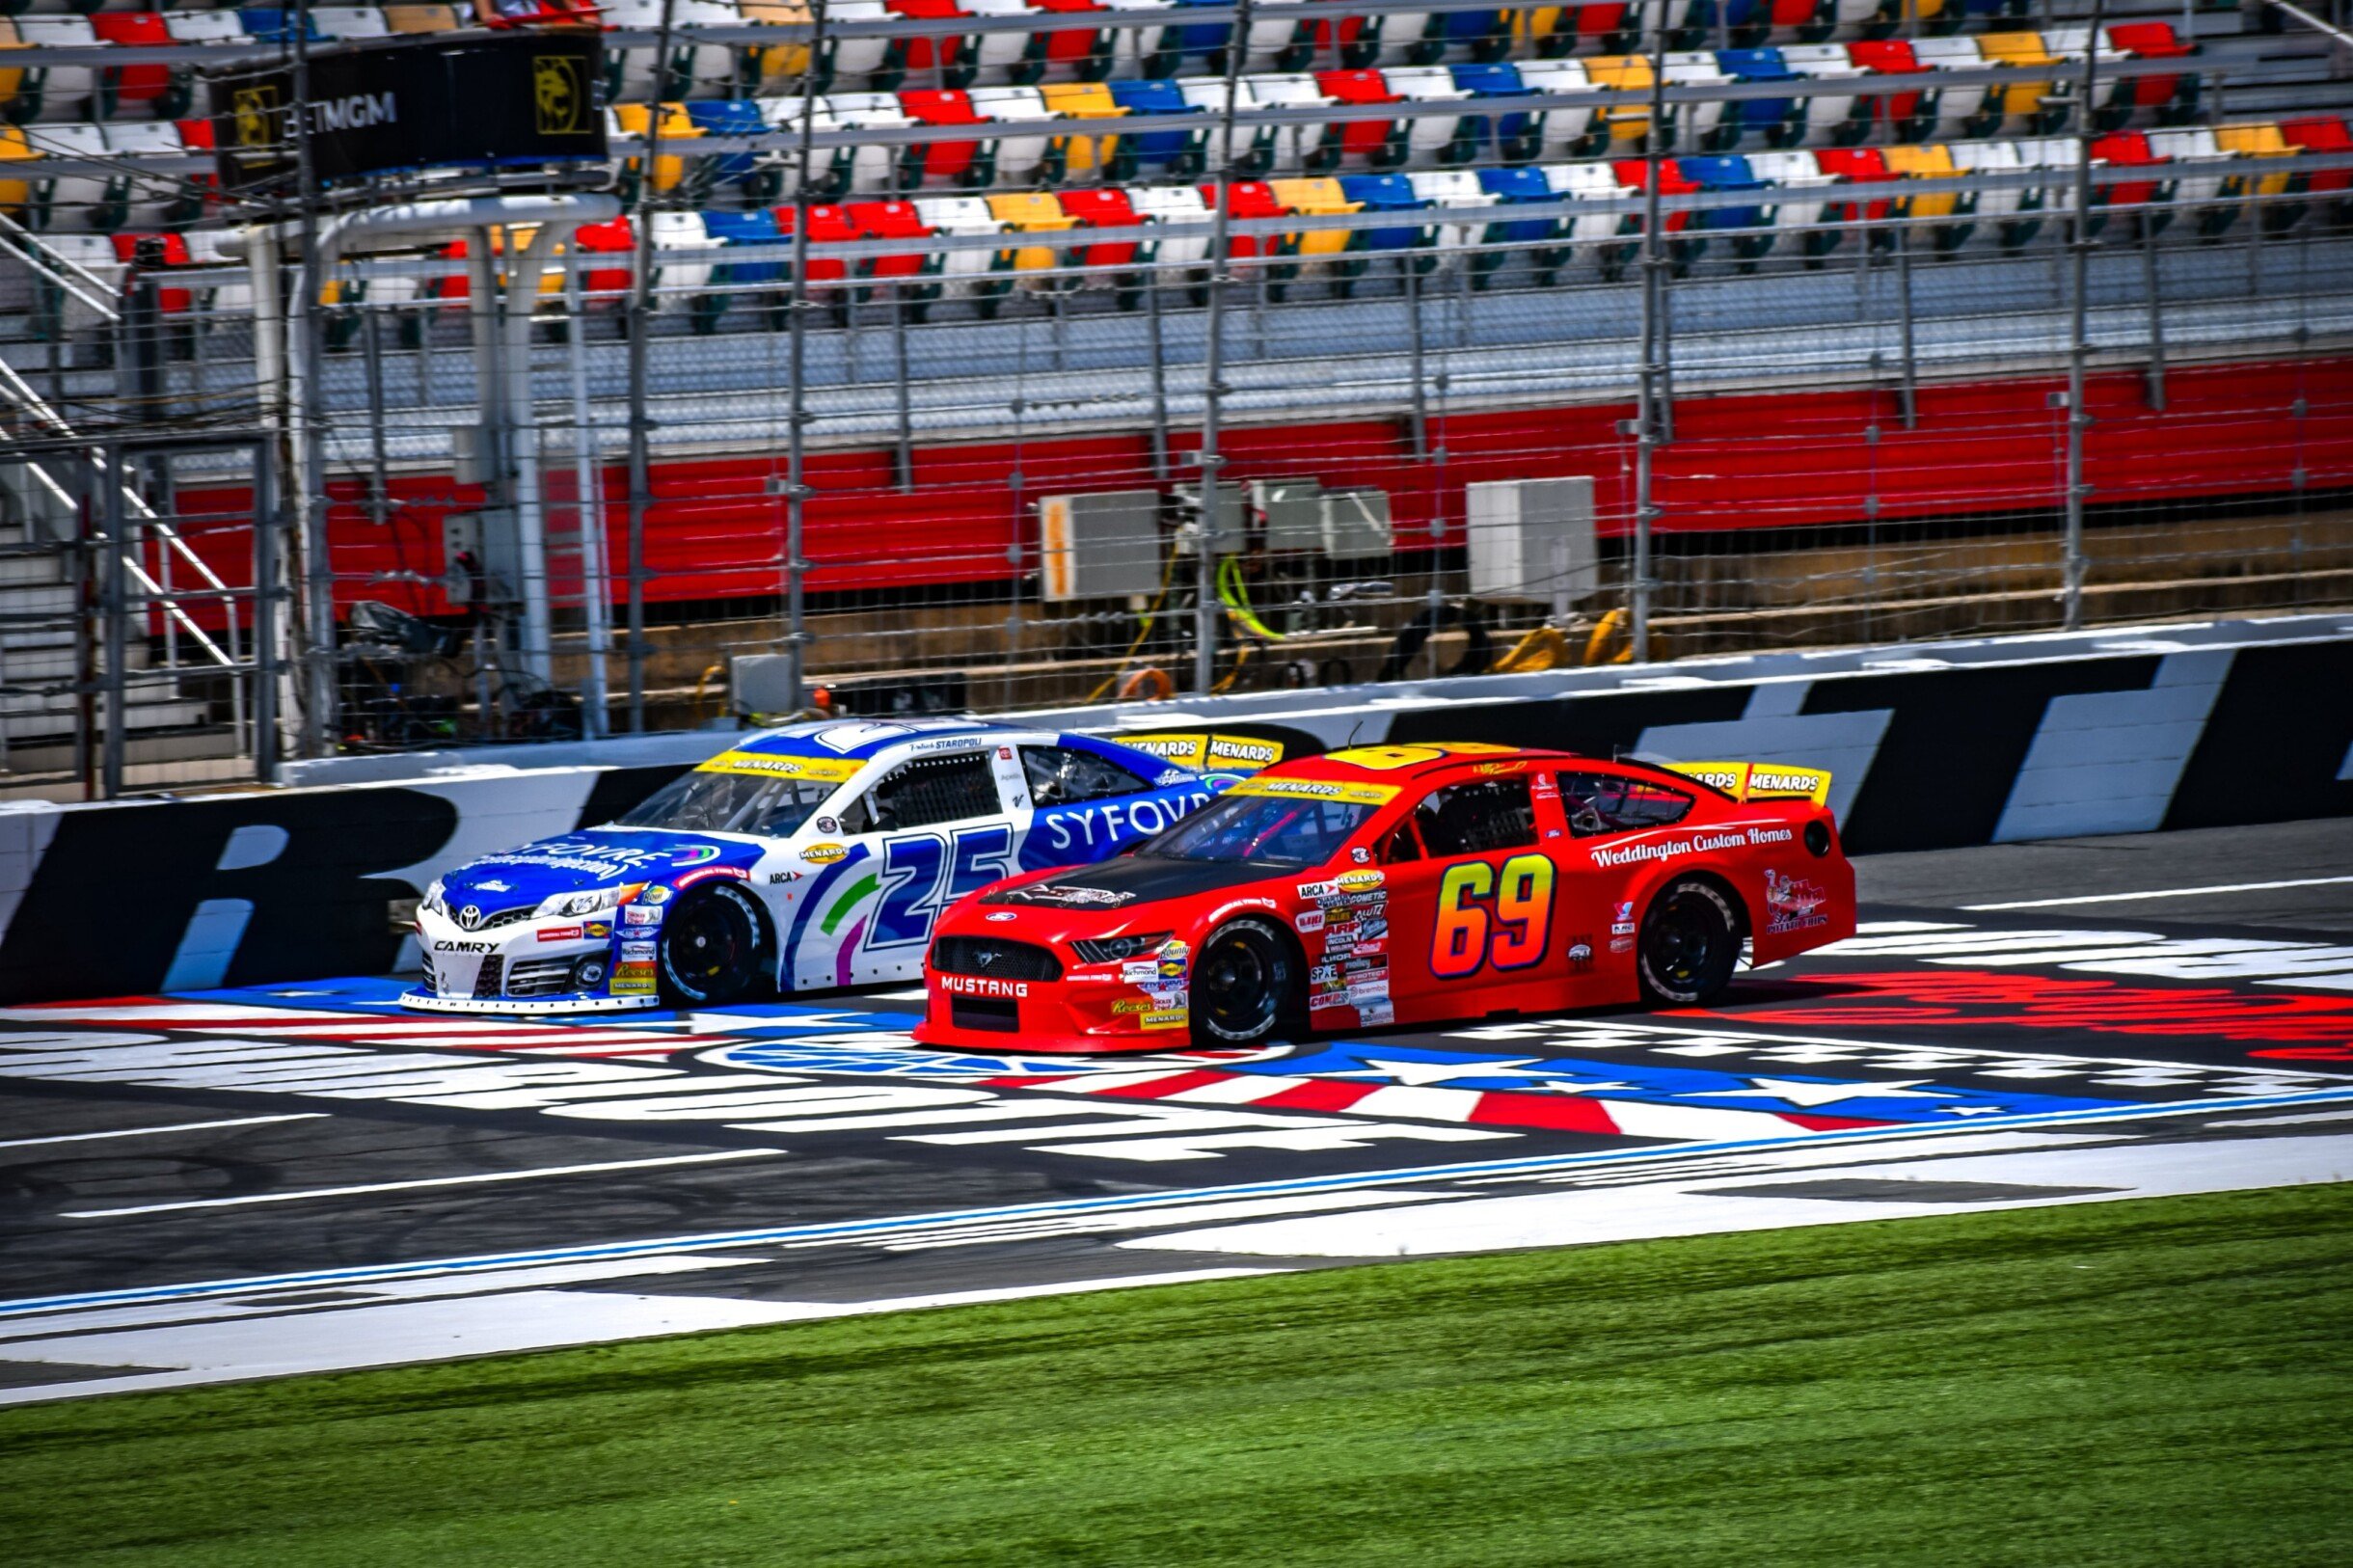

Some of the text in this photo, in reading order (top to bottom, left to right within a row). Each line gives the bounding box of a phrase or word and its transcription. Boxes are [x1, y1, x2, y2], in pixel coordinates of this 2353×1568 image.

[935, 737, 982, 749] STAROPOLI
[1209, 741, 1274, 761] MENARDS
[732, 760, 802, 773] MENARDS
[1691, 772, 1736, 788] ARDS
[1747, 773, 1819, 791] MENARDS
[1266, 782, 1342, 796] MENARDS
[1046, 792, 1211, 850] SYFOV
[799, 846, 850, 860] MENARDS
[1591, 826, 1792, 867] Weddington Custom Homes
[770, 872, 793, 884] ARCA
[1335, 873, 1383, 885] MENARDS
[870, 824, 1014, 952] 25
[1301, 884, 1324, 898] ARCA
[1351, 891, 1387, 903] COMETIC
[1428, 853, 1557, 979] 69
[434, 939, 500, 954] CAMRY
[1124, 967, 1157, 977] Richmond
[941, 976, 1028, 997] MUSTANG
[1145, 1014, 1187, 1023] MENARDS
